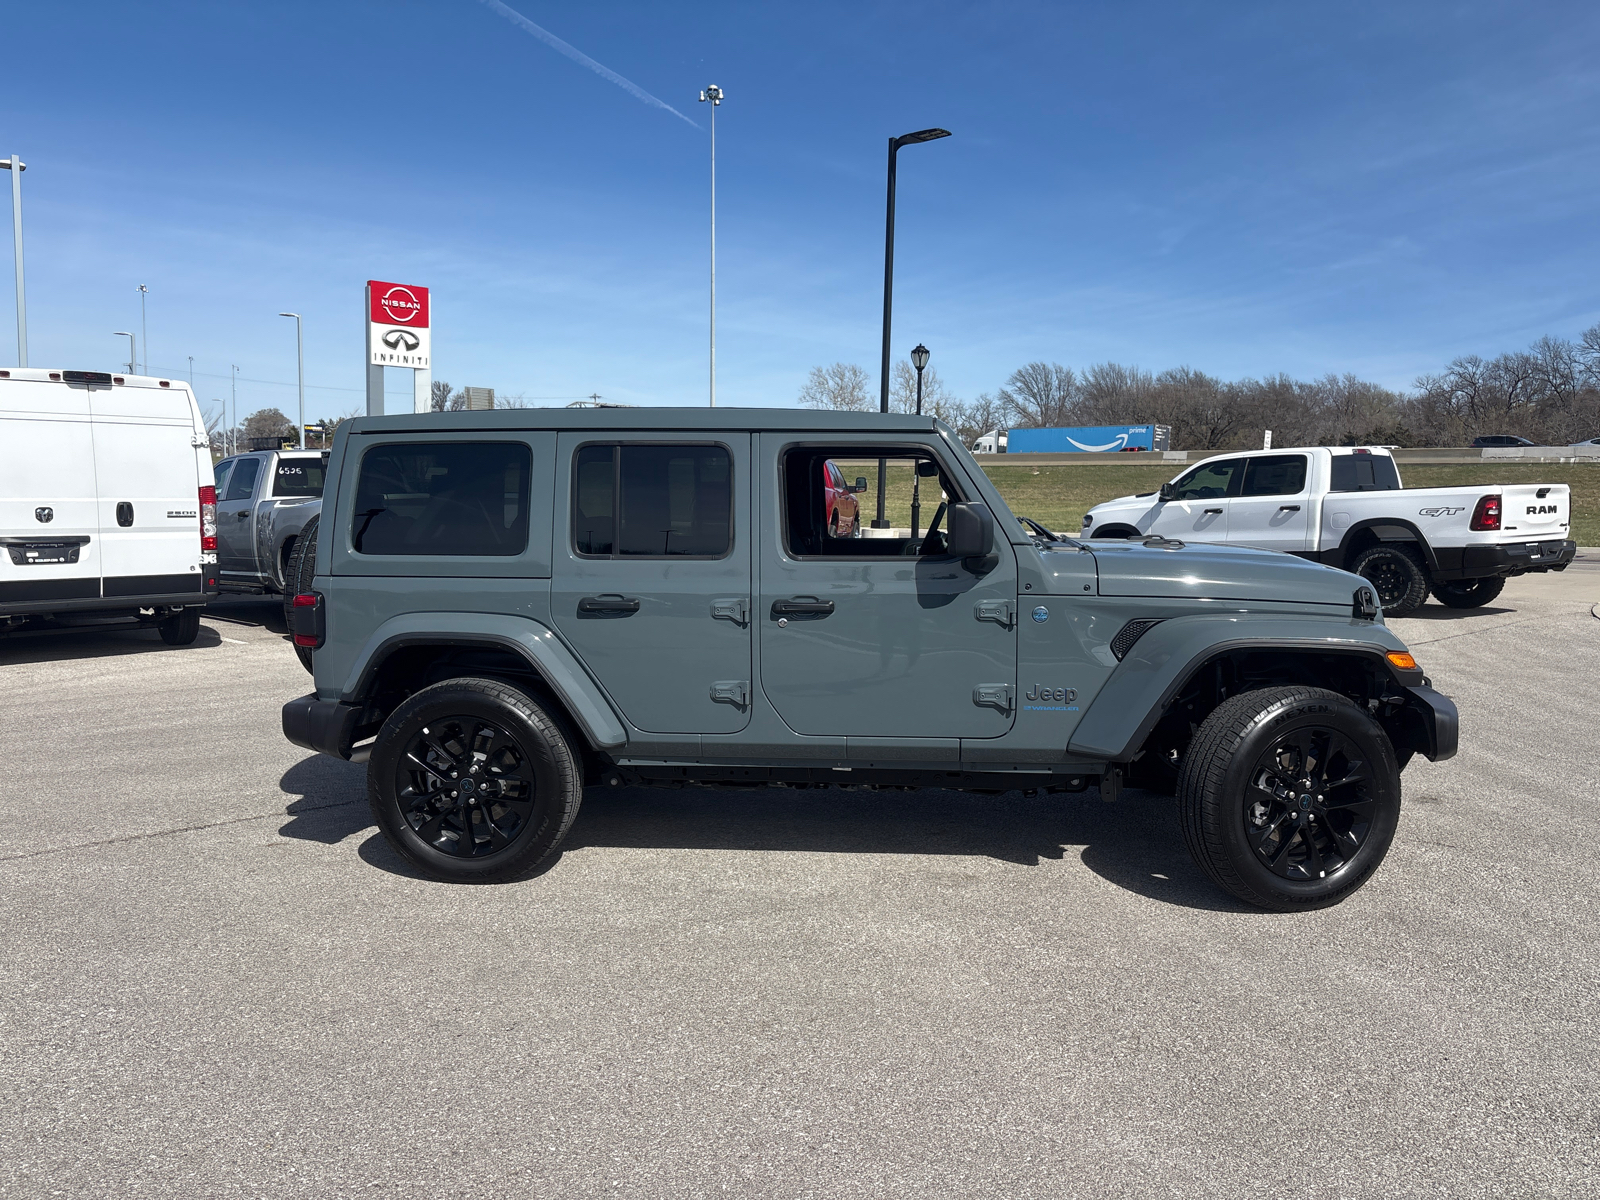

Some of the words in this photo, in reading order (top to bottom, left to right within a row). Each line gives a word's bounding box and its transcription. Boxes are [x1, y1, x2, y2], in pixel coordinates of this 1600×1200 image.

[381, 299, 420, 309] NISSAN
[374, 353, 428, 365] INFINITI
[1128, 427, 1147, 435] prime
[1525, 504, 1558, 515] RAM
[1026, 683, 1079, 705] Jeep
[1274, 705, 1329, 725] NEXEN
